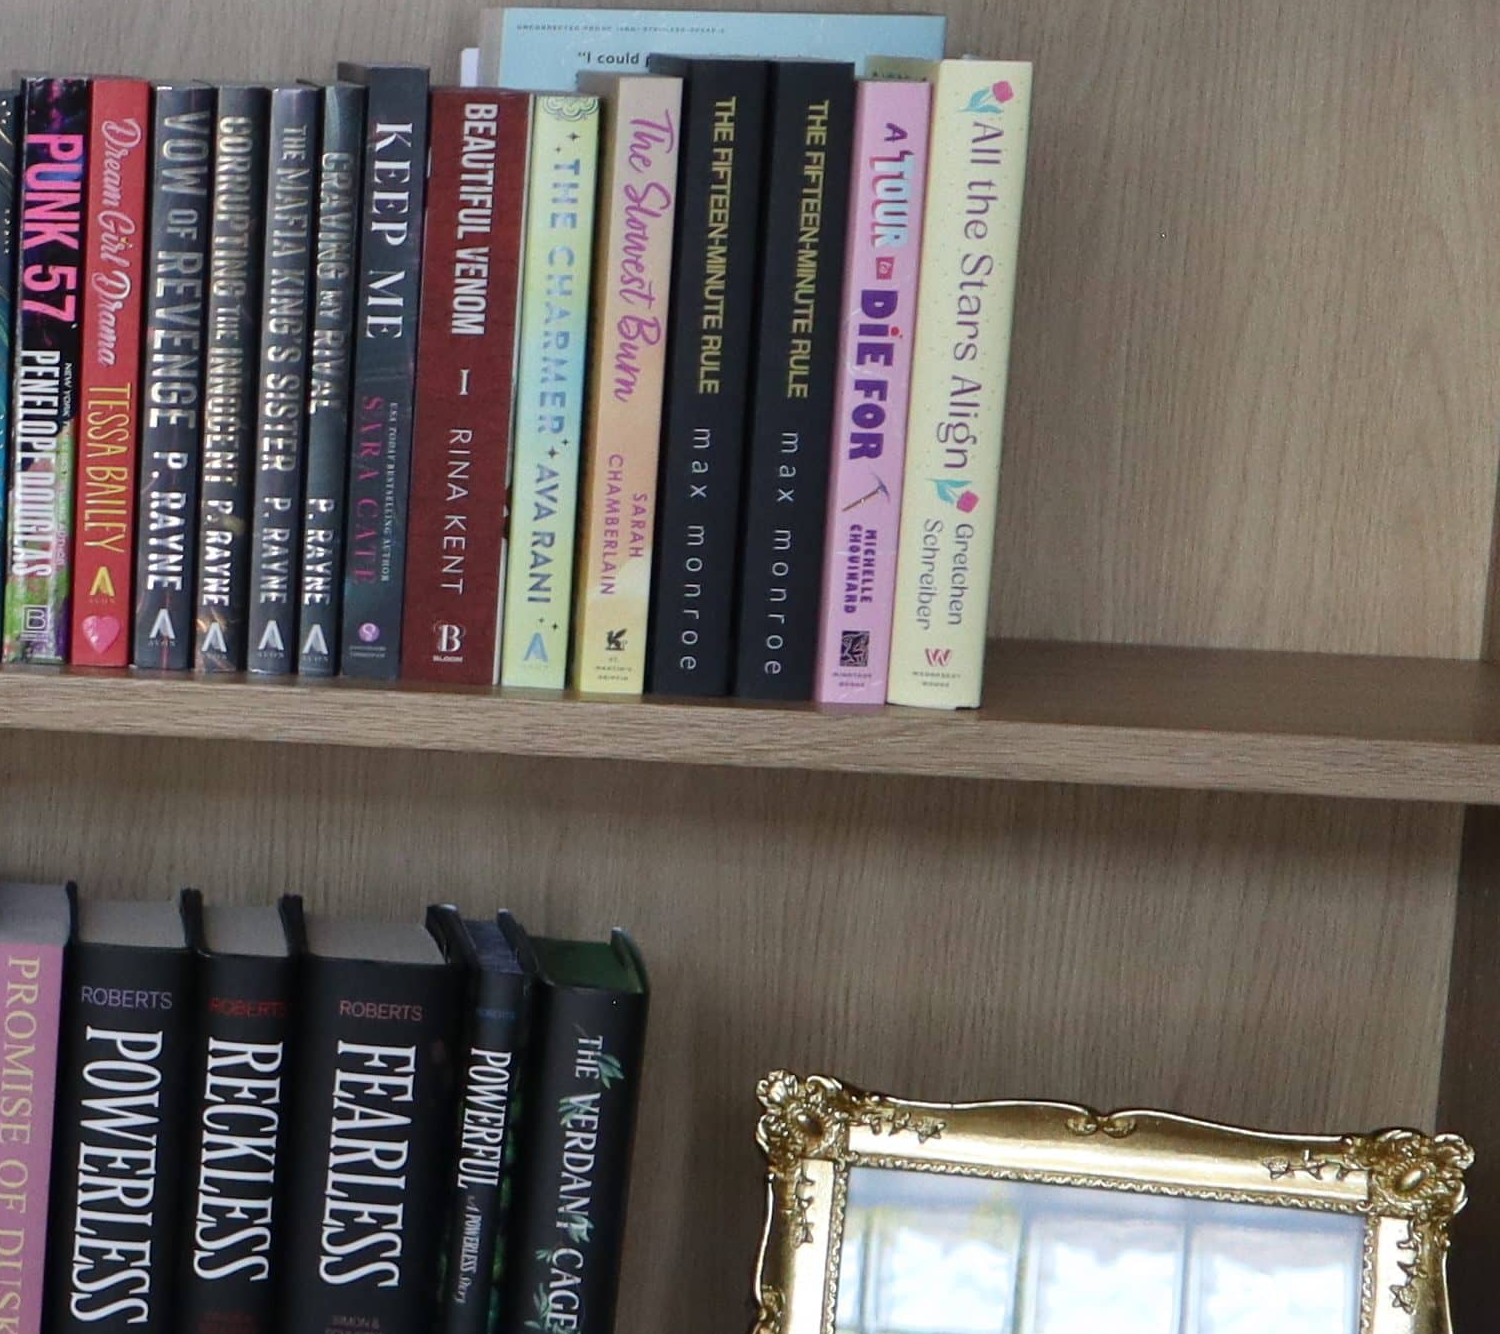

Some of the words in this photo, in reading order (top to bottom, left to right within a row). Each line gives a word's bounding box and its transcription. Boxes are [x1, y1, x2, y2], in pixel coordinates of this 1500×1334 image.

[597, 53, 639, 65] could
[25, 131, 84, 251] PUNK
[370, 121, 413, 249] KEEP
[456, 103, 498, 239] BEAUTIFUL
[28, 259, 78, 325] 57
[364, 270, 406, 340] ME
[453, 246, 485, 336] VENOM
[447, 427, 472, 499] RINA
[439, 508, 467, 596] KENT
[70, 1025, 164, 1326] POWERLESS
[192, 1036, 284, 1283] RECKLESS
[319, 1039, 416, 1289] FEARLESS
